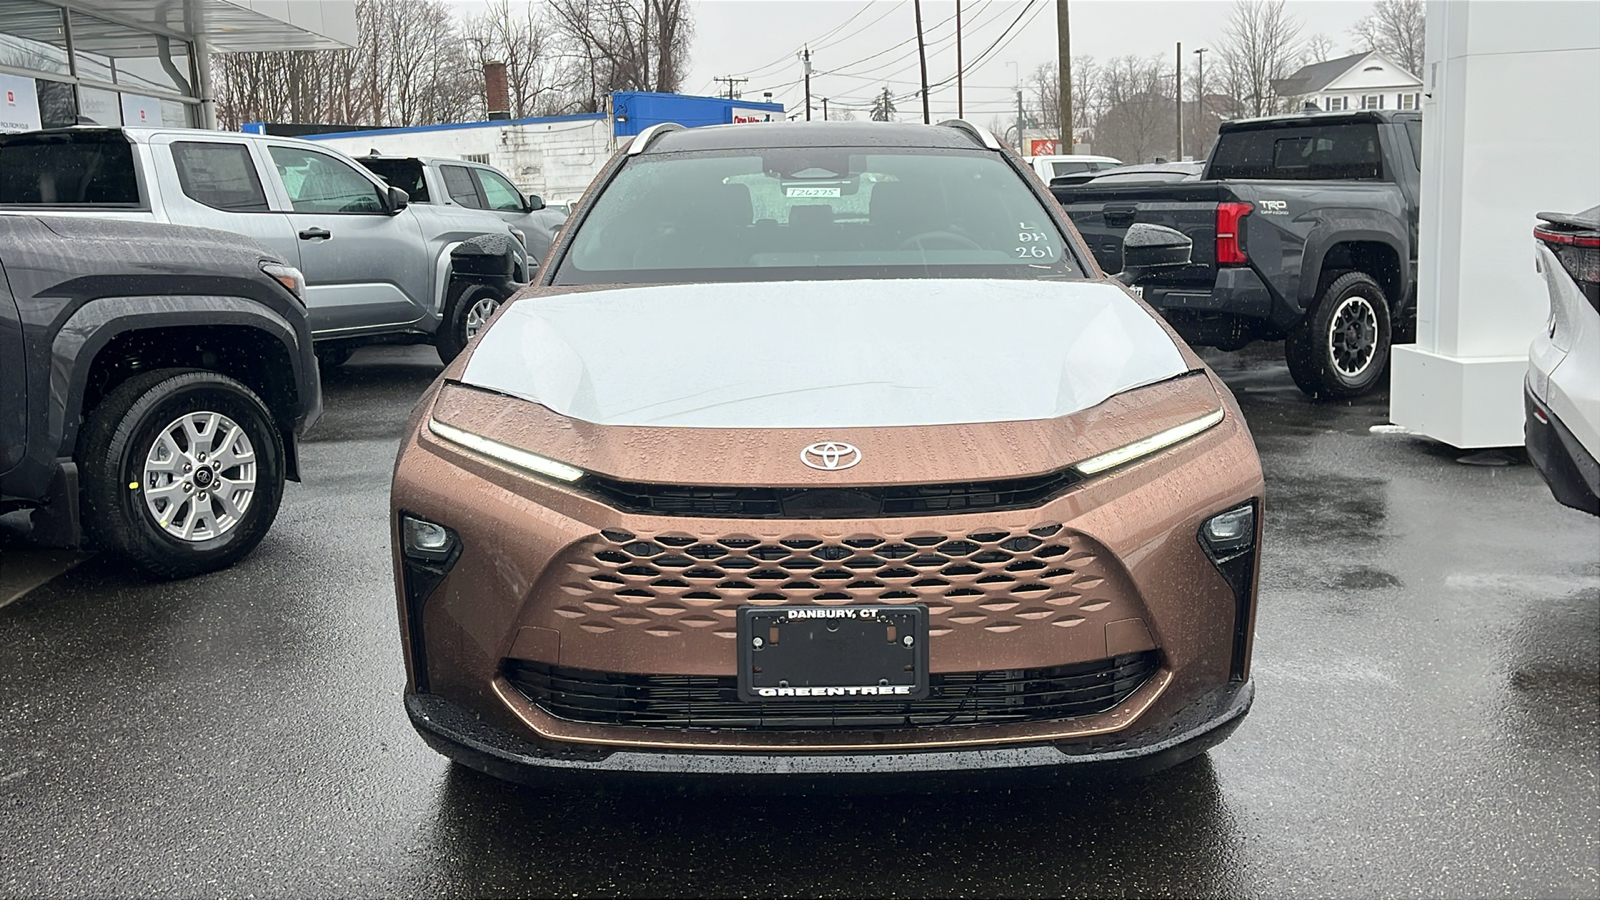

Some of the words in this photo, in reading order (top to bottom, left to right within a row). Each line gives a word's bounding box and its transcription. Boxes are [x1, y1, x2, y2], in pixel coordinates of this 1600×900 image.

[789, 188, 838, 196] T26275
[1258, 200, 1287, 210] TRD
[1015, 246, 1054, 258] 261
[788, 609, 857, 619] DANBURY,
[859, 609, 879, 618] CT
[758, 686, 910, 697] GREENTREE
